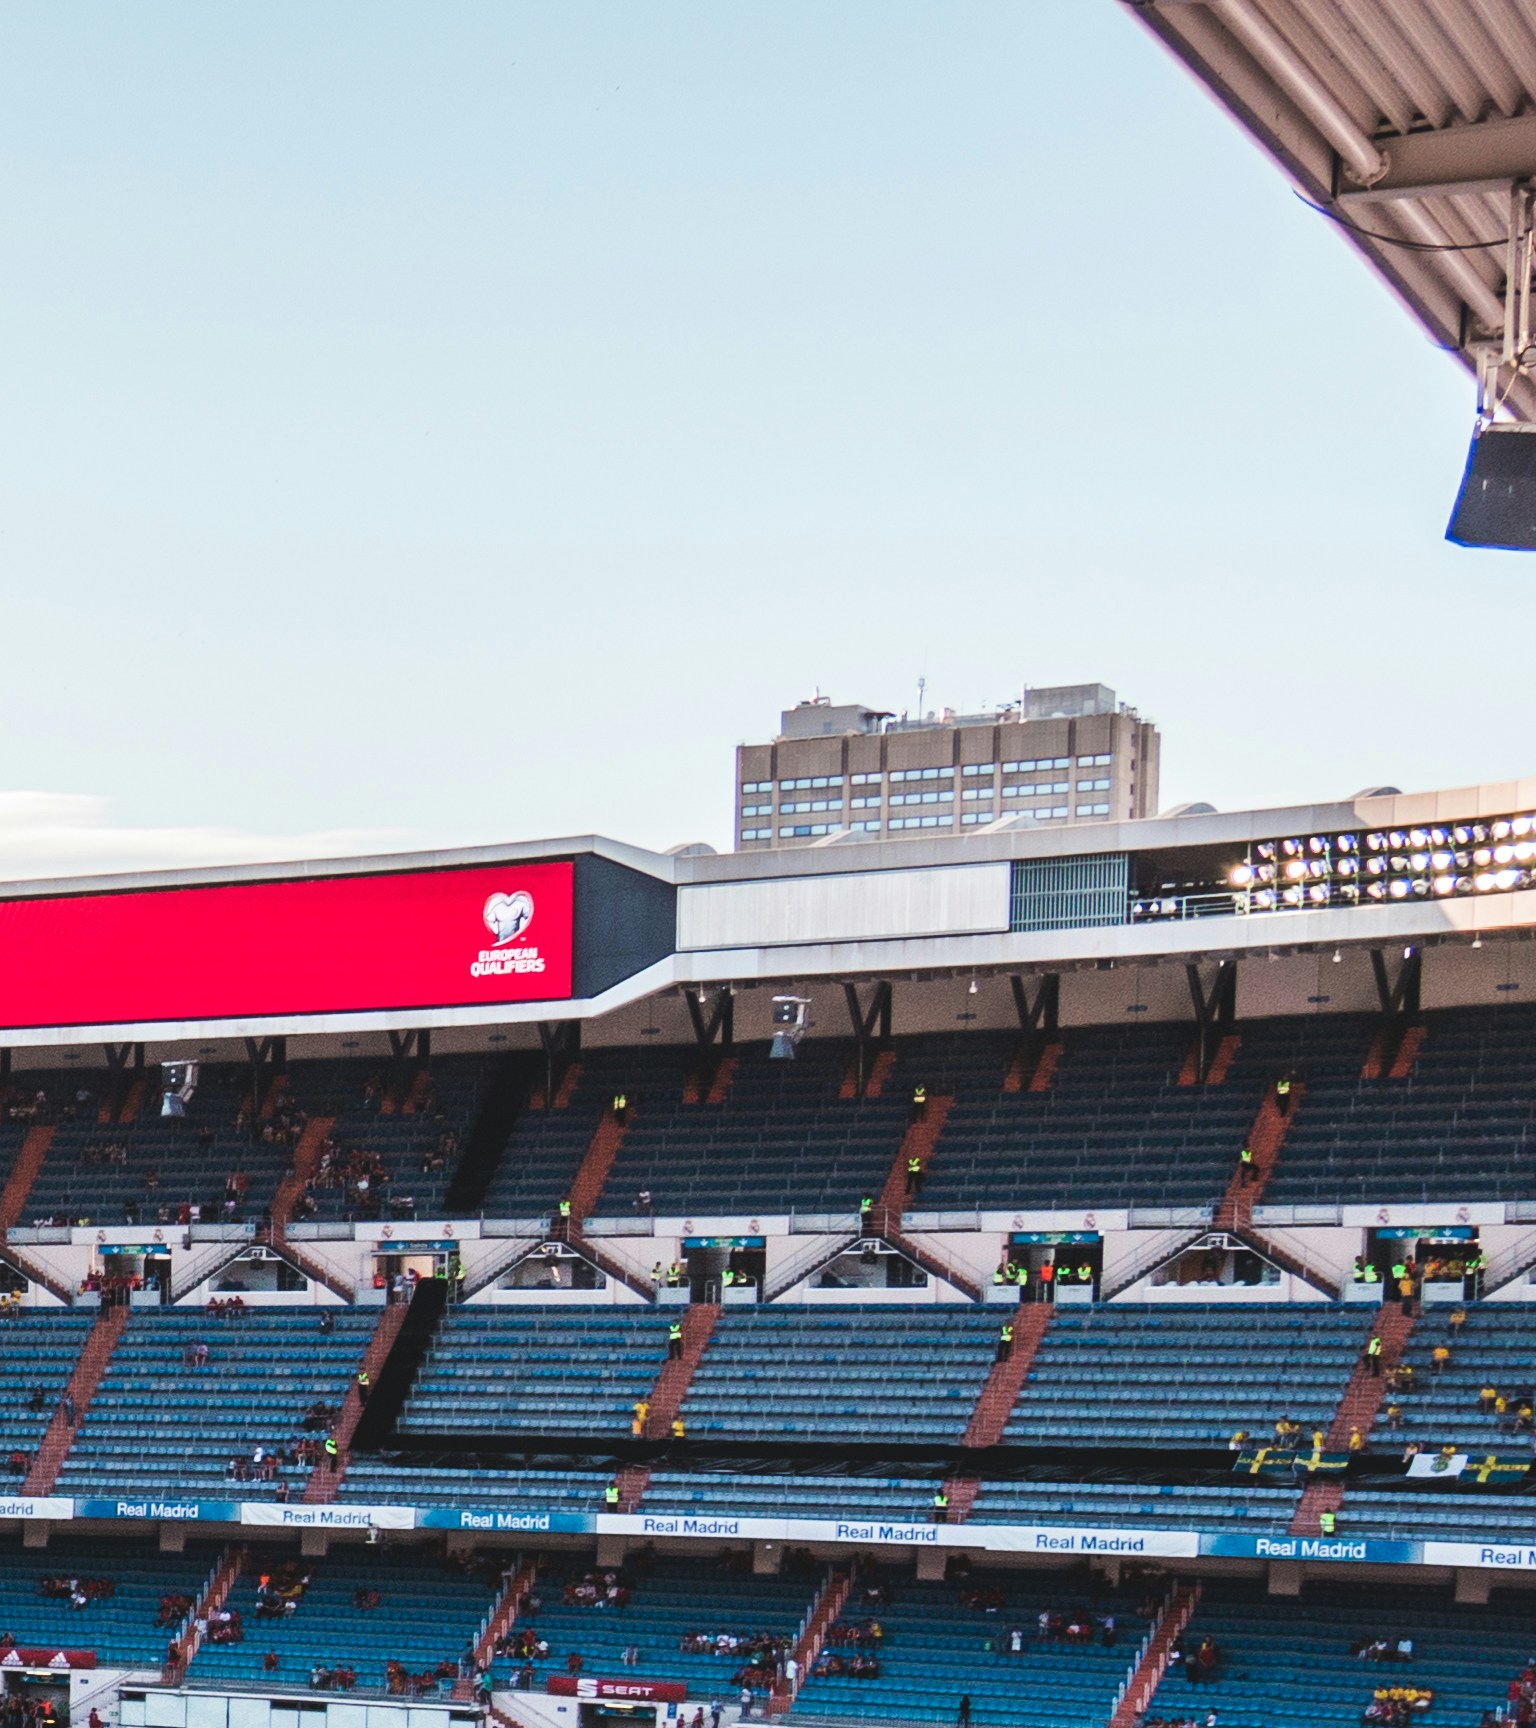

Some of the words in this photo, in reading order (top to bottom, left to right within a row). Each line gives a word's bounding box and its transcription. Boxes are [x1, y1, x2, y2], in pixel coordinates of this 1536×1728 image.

[478, 947, 538, 962] EUROPEAN
[470, 958, 546, 977] QUALIFIERS
[116, 1504, 145, 1516] Real
[147, 1504, 199, 1518] Madrid
[283, 1511, 316, 1523] Real
[320, 1512, 371, 1525] Madrid
[461, 1513, 494, 1527] Real
[497, 1514, 550, 1529] Madrid
[644, 1519, 679, 1533] Real
[683, 1519, 738, 1535] Madrid
[838, 1525, 874, 1539] Real
[879, 1525, 937, 1542] Madrid
[1036, 1534, 1074, 1549] Real
[1080, 1535, 1144, 1552] Madrid
[1256, 1539, 1293, 1554] Real
[1297, 1540, 1366, 1558] Madrid
[1481, 1549, 1521, 1564] Real
[602, 1684, 654, 1697] SEAT
